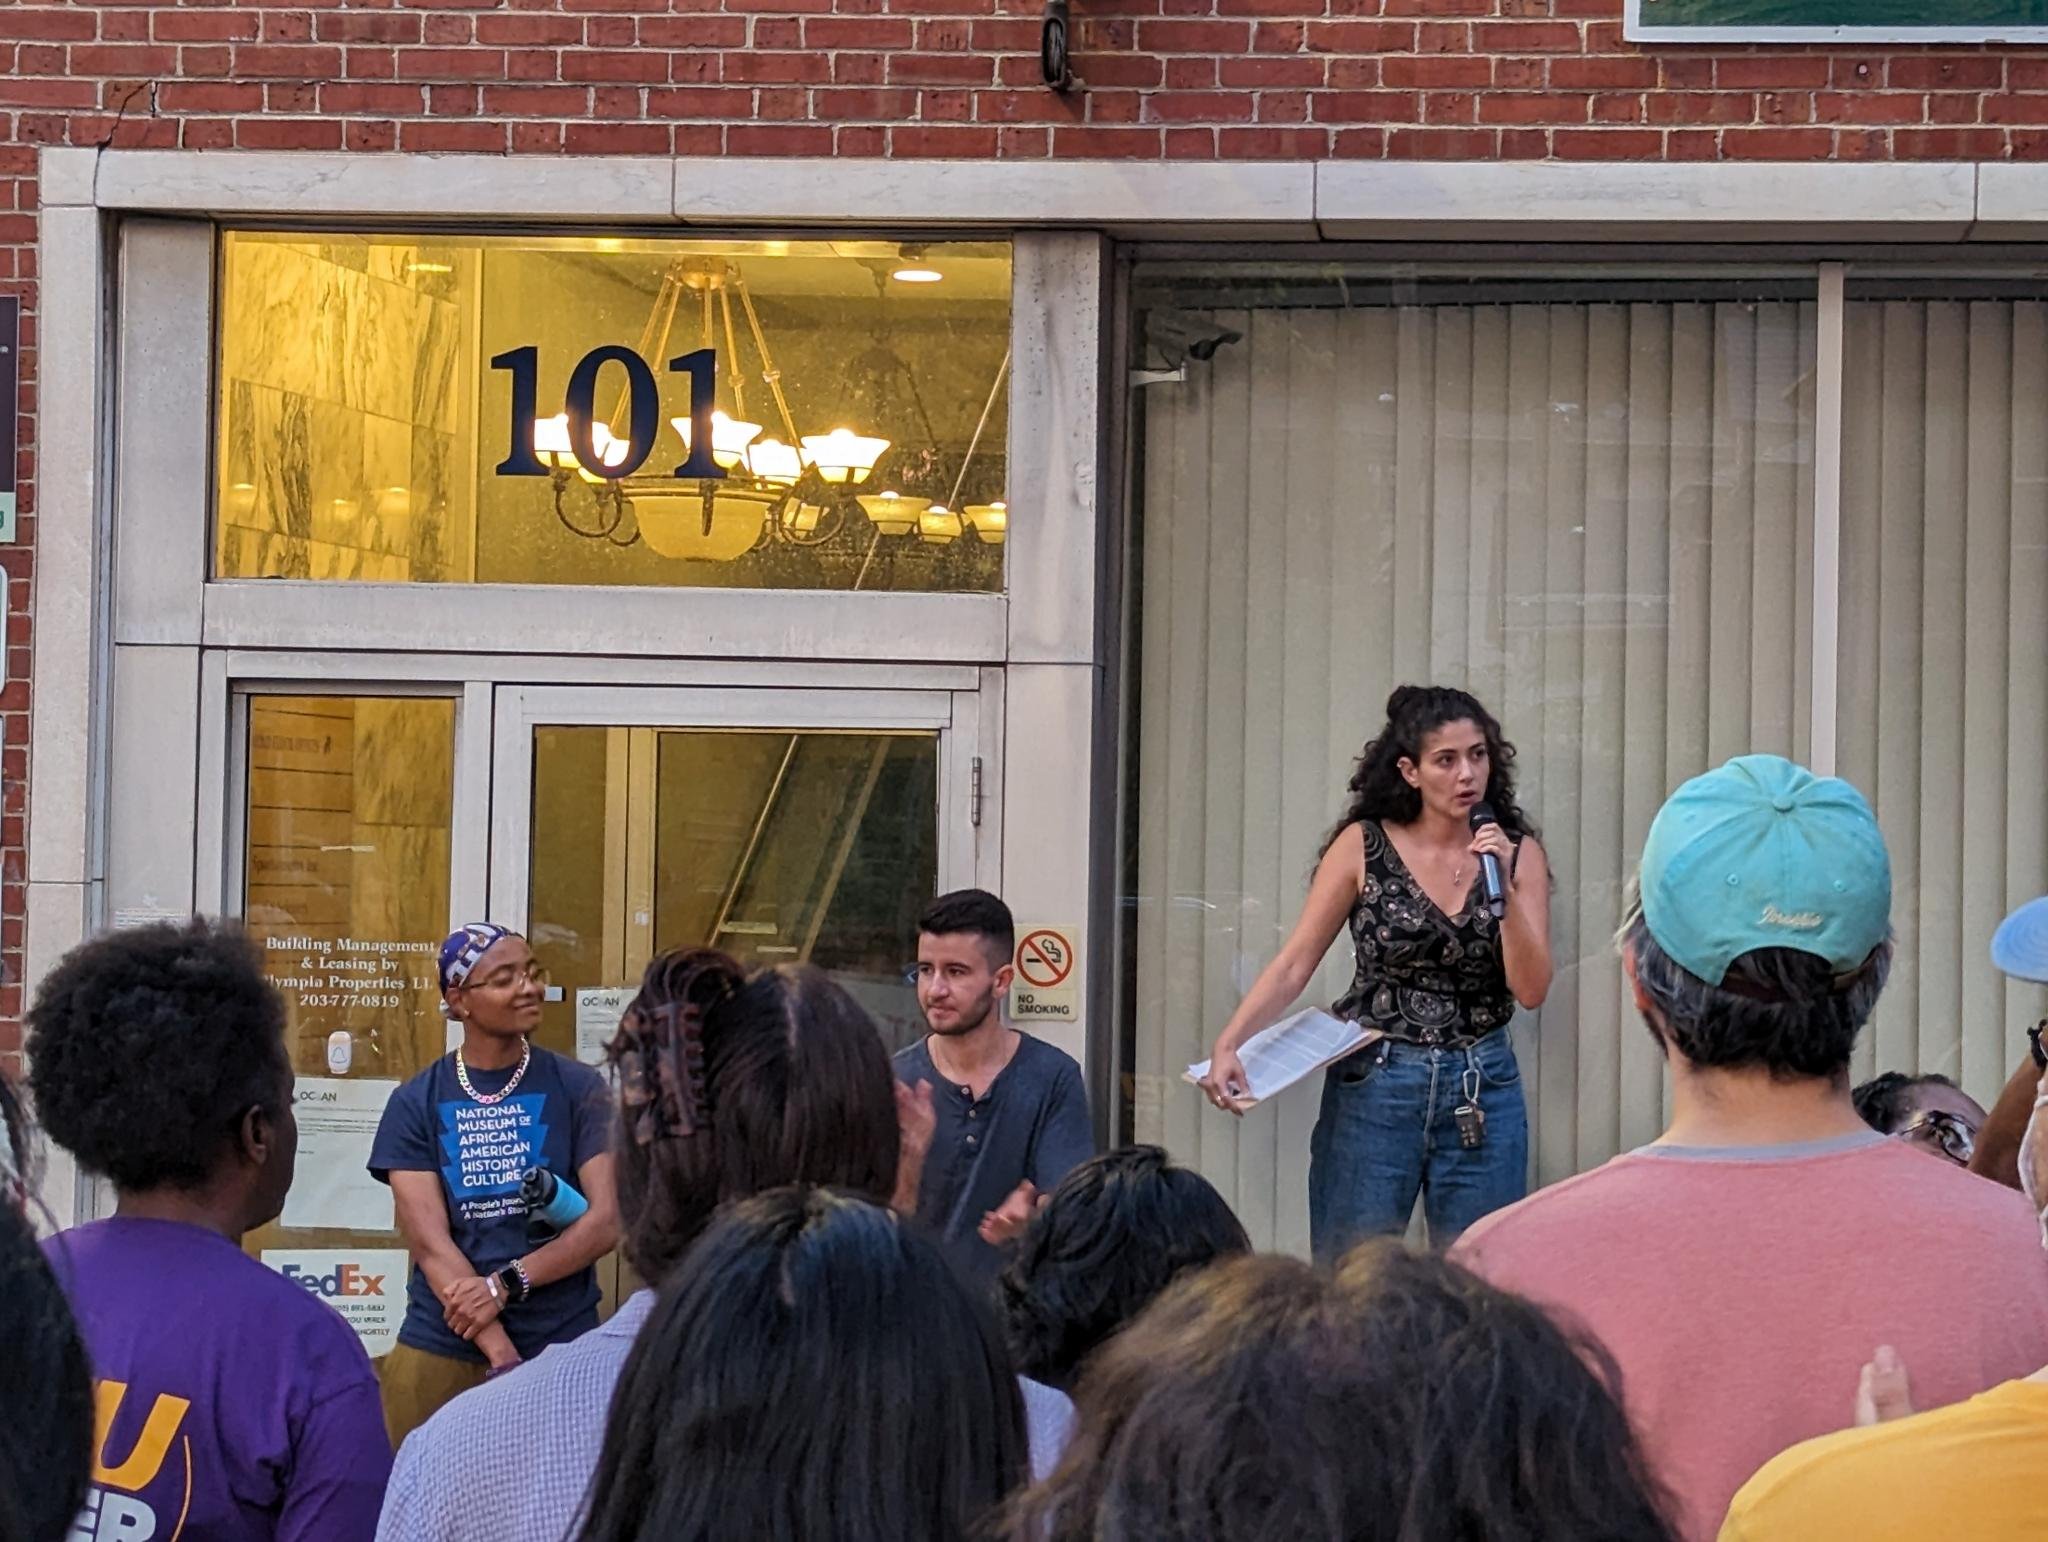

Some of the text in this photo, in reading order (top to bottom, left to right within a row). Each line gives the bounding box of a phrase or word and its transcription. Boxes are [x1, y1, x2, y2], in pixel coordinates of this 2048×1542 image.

[491, 345, 728, 479] 101
[266, 936, 434, 953] Building Management
[301, 957, 399, 972] & Leasing by
[264, 974, 323, 991] lympia
[329, 976, 405, 991] Properties
[300, 994, 399, 1007] 203-777-0819
[1018, 995, 1034, 1003] NO
[1018, 1004, 1069, 1014] SMOKING
[456, 1104, 525, 1120] NATIONAL
[458, 1115, 532, 1132] MUSEUM OF
[459, 1130, 518, 1146] AFRICAN
[461, 1142, 530, 1159] AMERICAN
[462, 1157, 518, 1173] HISTORY
[463, 1169, 522, 1187] CULTURE
[460, 1203, 467, 1211] A
[464, 1211, 471, 1220] A
[282, 1264, 386, 1297] FedEx
